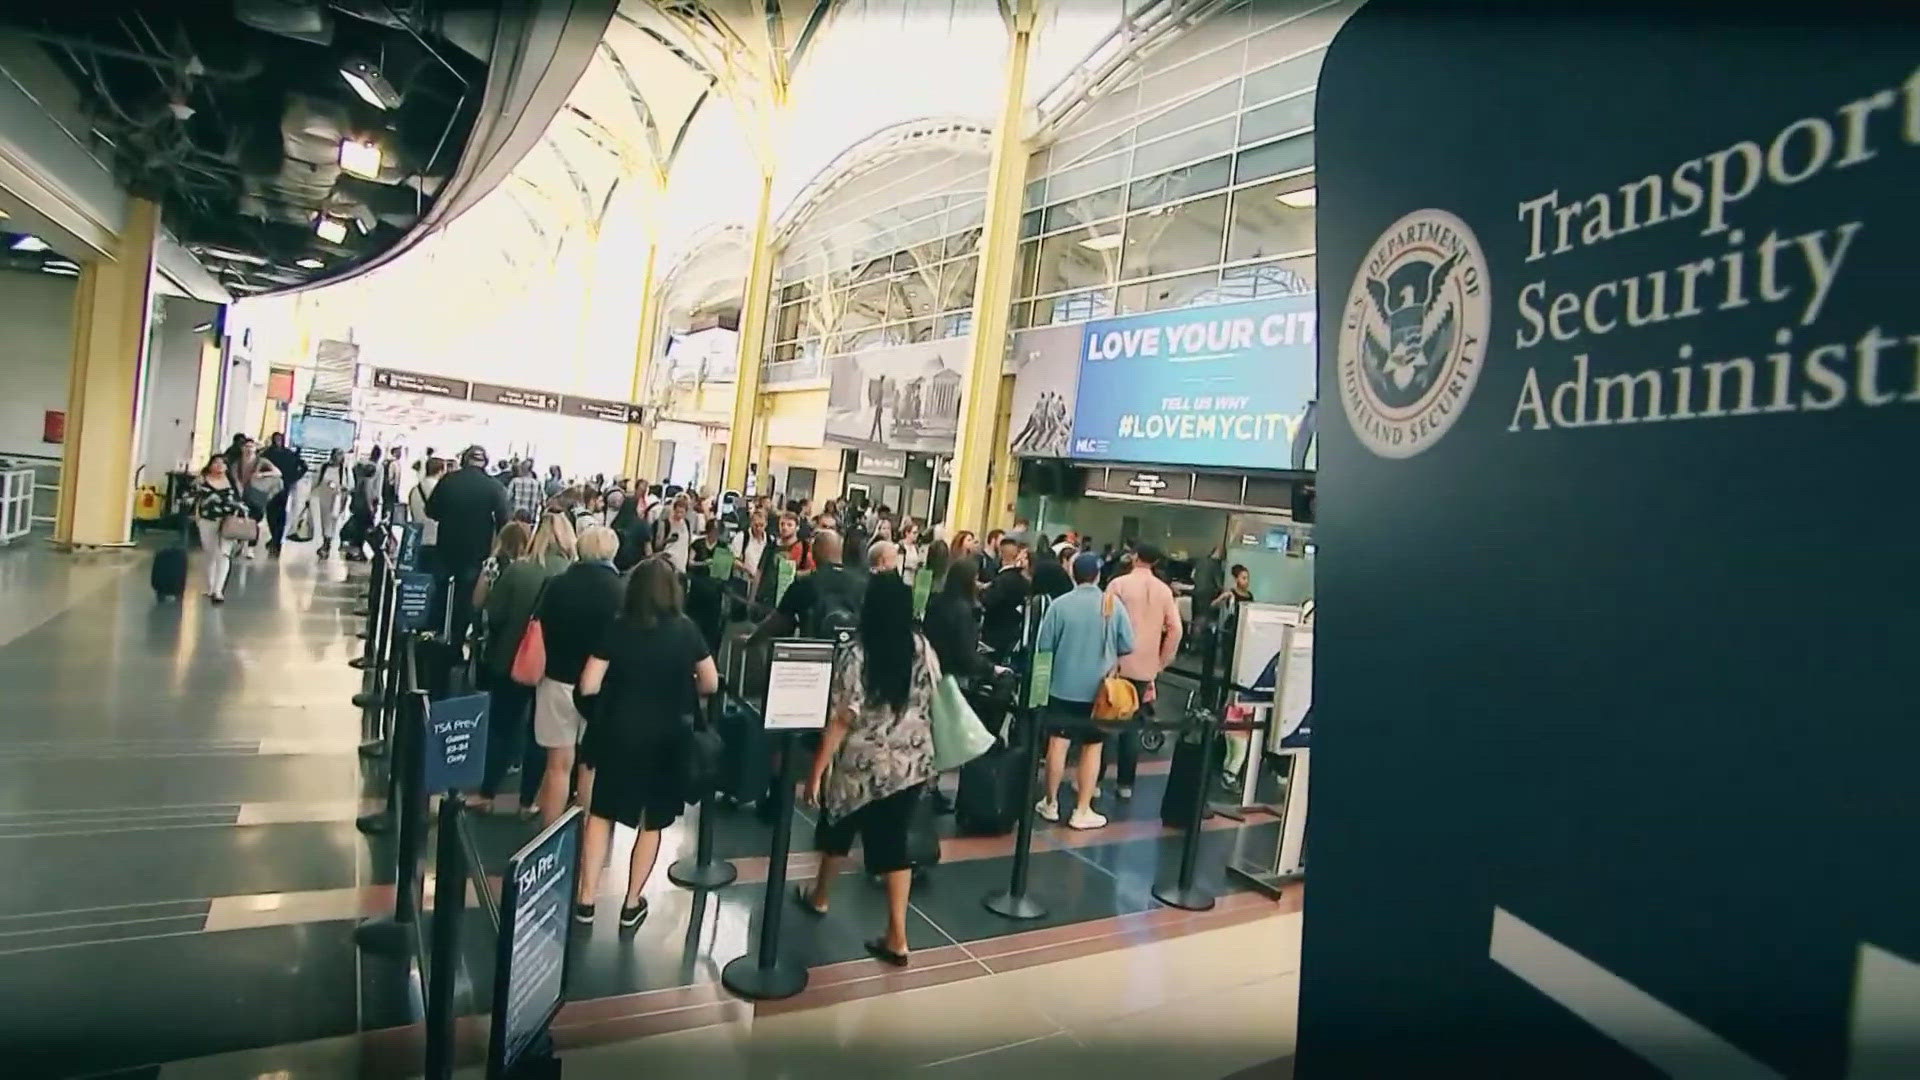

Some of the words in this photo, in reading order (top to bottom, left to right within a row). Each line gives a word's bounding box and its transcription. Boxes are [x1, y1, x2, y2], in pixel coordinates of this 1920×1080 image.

[1368, 221, 1469, 275] DEPARTMENT
[1463, 266, 1481, 298] OF
[1515, 220, 1865, 350] Security
[1088, 328, 1160, 361] LOVE
[1167, 319, 1253, 354] YOUR
[1161, 396, 1192, 411] TELL
[1193, 396, 1213, 410] US
[1215, 395, 1250, 410] WHY
[1345, 359, 1403, 446] HOMELAND
[1409, 334, 1479, 445] SECURITY
[1119, 414, 1303, 442] #LOVEMYCITY
[1076, 440, 1097, 452] NLC
[434, 721, 452, 735] TSA
[519, 865, 537, 897] TSA
